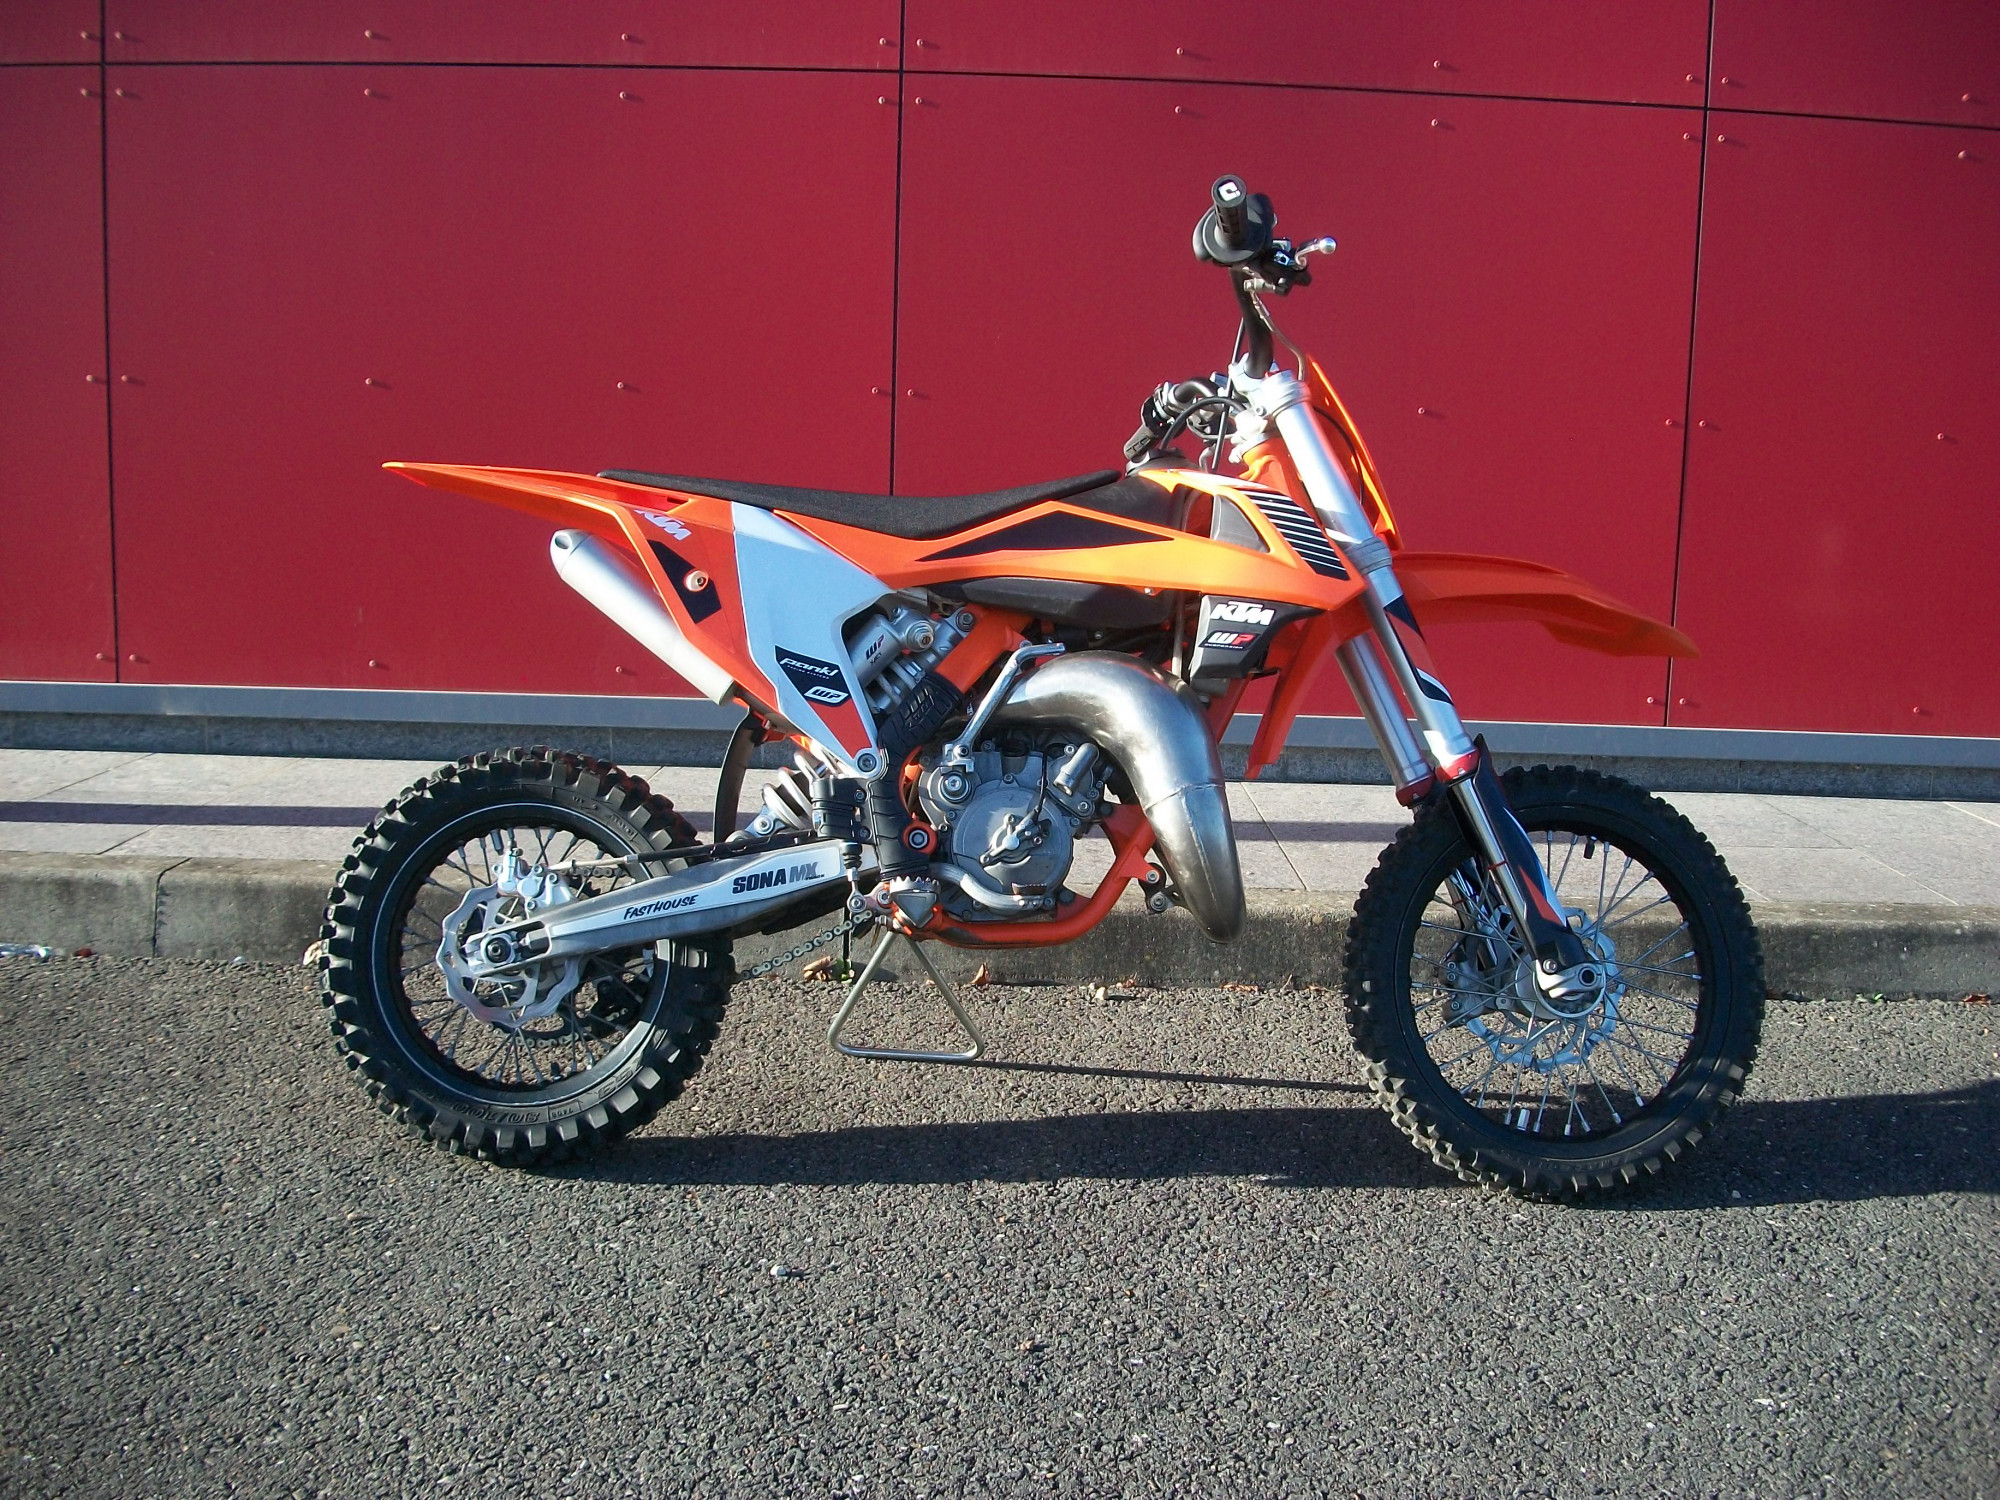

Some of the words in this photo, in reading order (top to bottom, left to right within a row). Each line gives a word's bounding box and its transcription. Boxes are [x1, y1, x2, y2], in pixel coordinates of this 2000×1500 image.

[1210, 600, 1276, 626] KTM
[865, 634, 885, 660] WP
[1207, 631, 1255, 645] WP
[779, 657, 839, 677] pankl
[810, 688, 842, 700] WP
[732, 868, 787, 894] SONA
[789, 861, 818, 883] MX
[623, 894, 699, 920] FASTHOUSE
